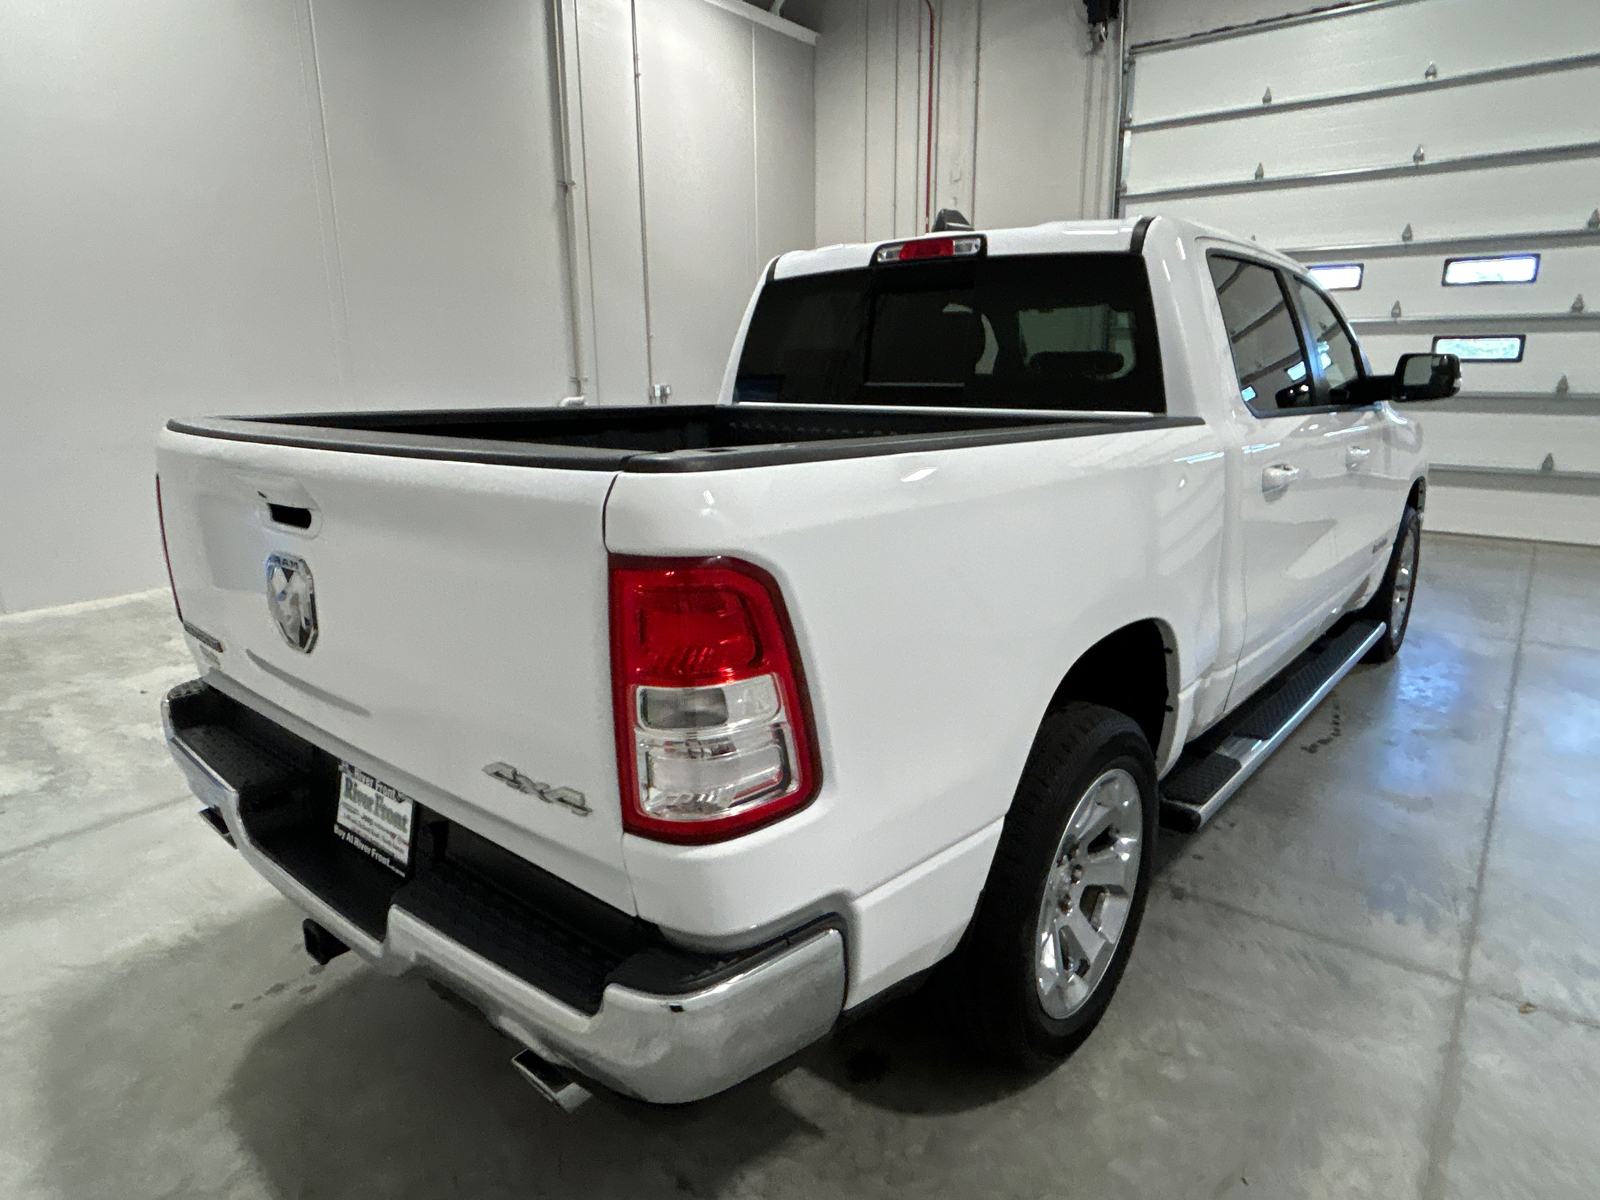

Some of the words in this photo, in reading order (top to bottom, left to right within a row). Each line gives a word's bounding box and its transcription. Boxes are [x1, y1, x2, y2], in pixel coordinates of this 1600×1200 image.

[273, 555, 299, 570] RAM
[354, 766, 375, 789] River
[376, 780, 397, 800] Front
[344, 776, 374, 813] River
[373, 792, 408, 833] Front
[334, 824, 346, 841] Buy
[353, 838, 371, 855] River
